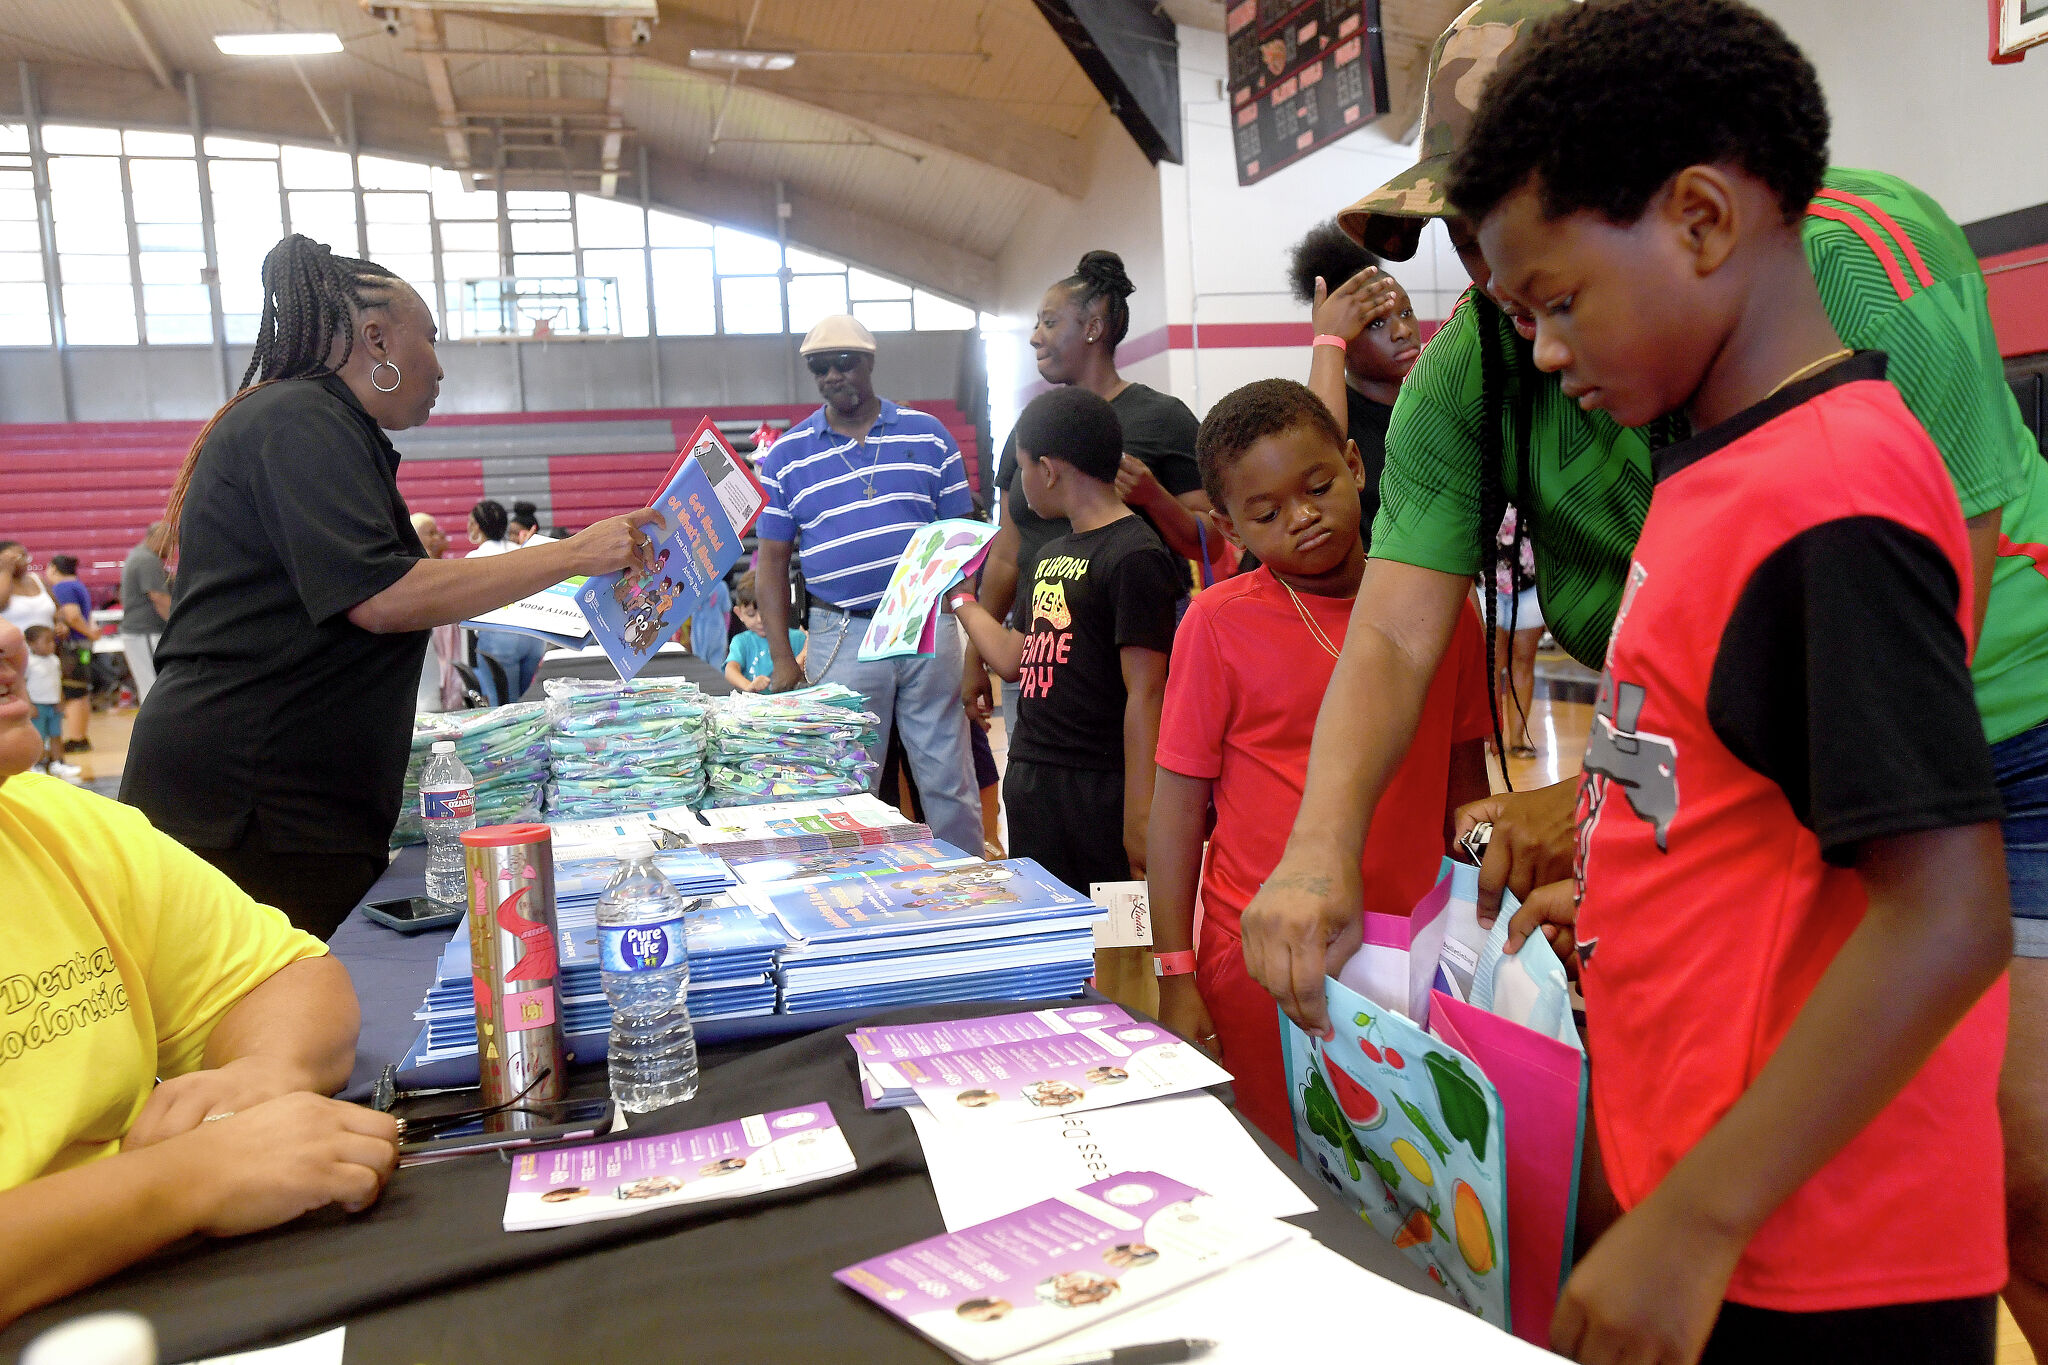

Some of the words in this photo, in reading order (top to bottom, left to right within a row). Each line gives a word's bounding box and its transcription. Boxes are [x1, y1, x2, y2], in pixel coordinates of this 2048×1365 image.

[688, 493, 705, 518] Get
[701, 515, 724, 552] Ahead
[668, 495, 682, 511] of
[677, 508, 701, 548] What's
[697, 544, 720, 581] Ahead
[518, 602, 544, 612] BOOK
[545, 606, 584, 619] CTIVITY
[1131, 898, 1147, 938] Linda's
[627, 928, 662, 943] Pure
[632, 941, 660, 959] Life
[0, 981, 129, 1065] odontic
